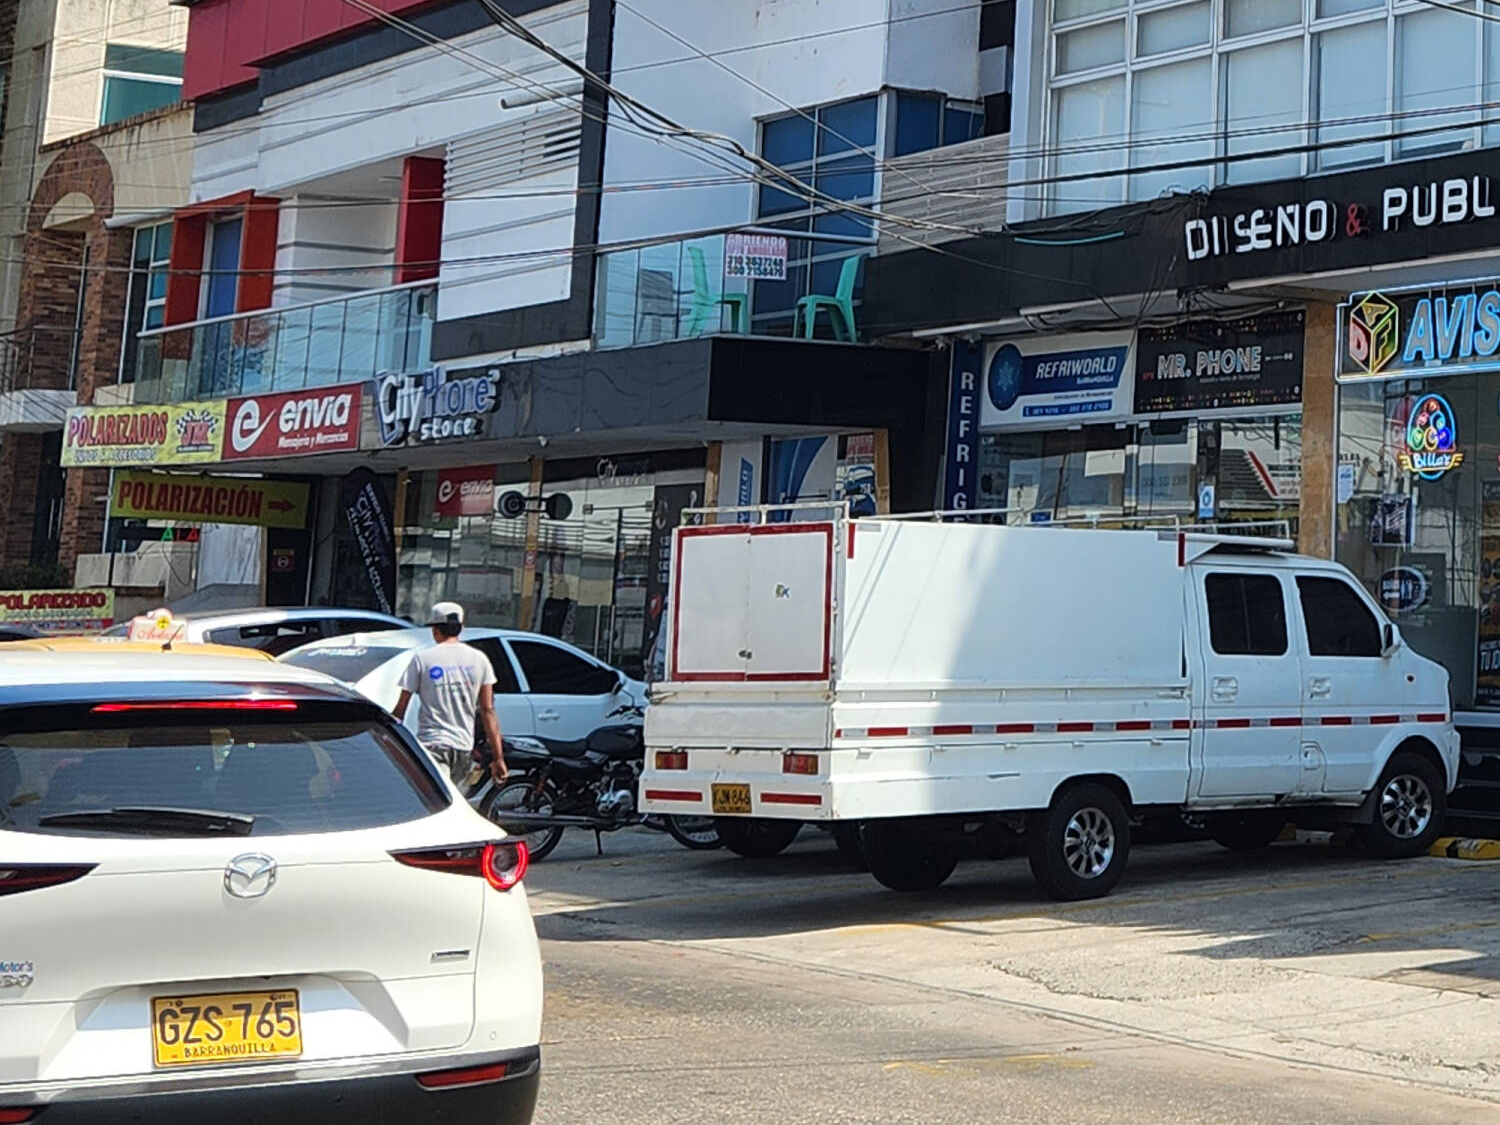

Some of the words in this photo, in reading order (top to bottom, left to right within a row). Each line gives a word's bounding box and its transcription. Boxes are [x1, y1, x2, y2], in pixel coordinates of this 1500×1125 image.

[1346, 202, 1362, 237] &
[1036, 356, 1117, 380] REFRIWORLD
[1195, 345, 1262, 377] PHONE
[67, 411, 168, 448] POLARIZADOS
[117, 481, 264, 519] POLARIZACIÓN
[159, 1005, 223, 1045] GZS
[233, 1001, 296, 1040] 765
